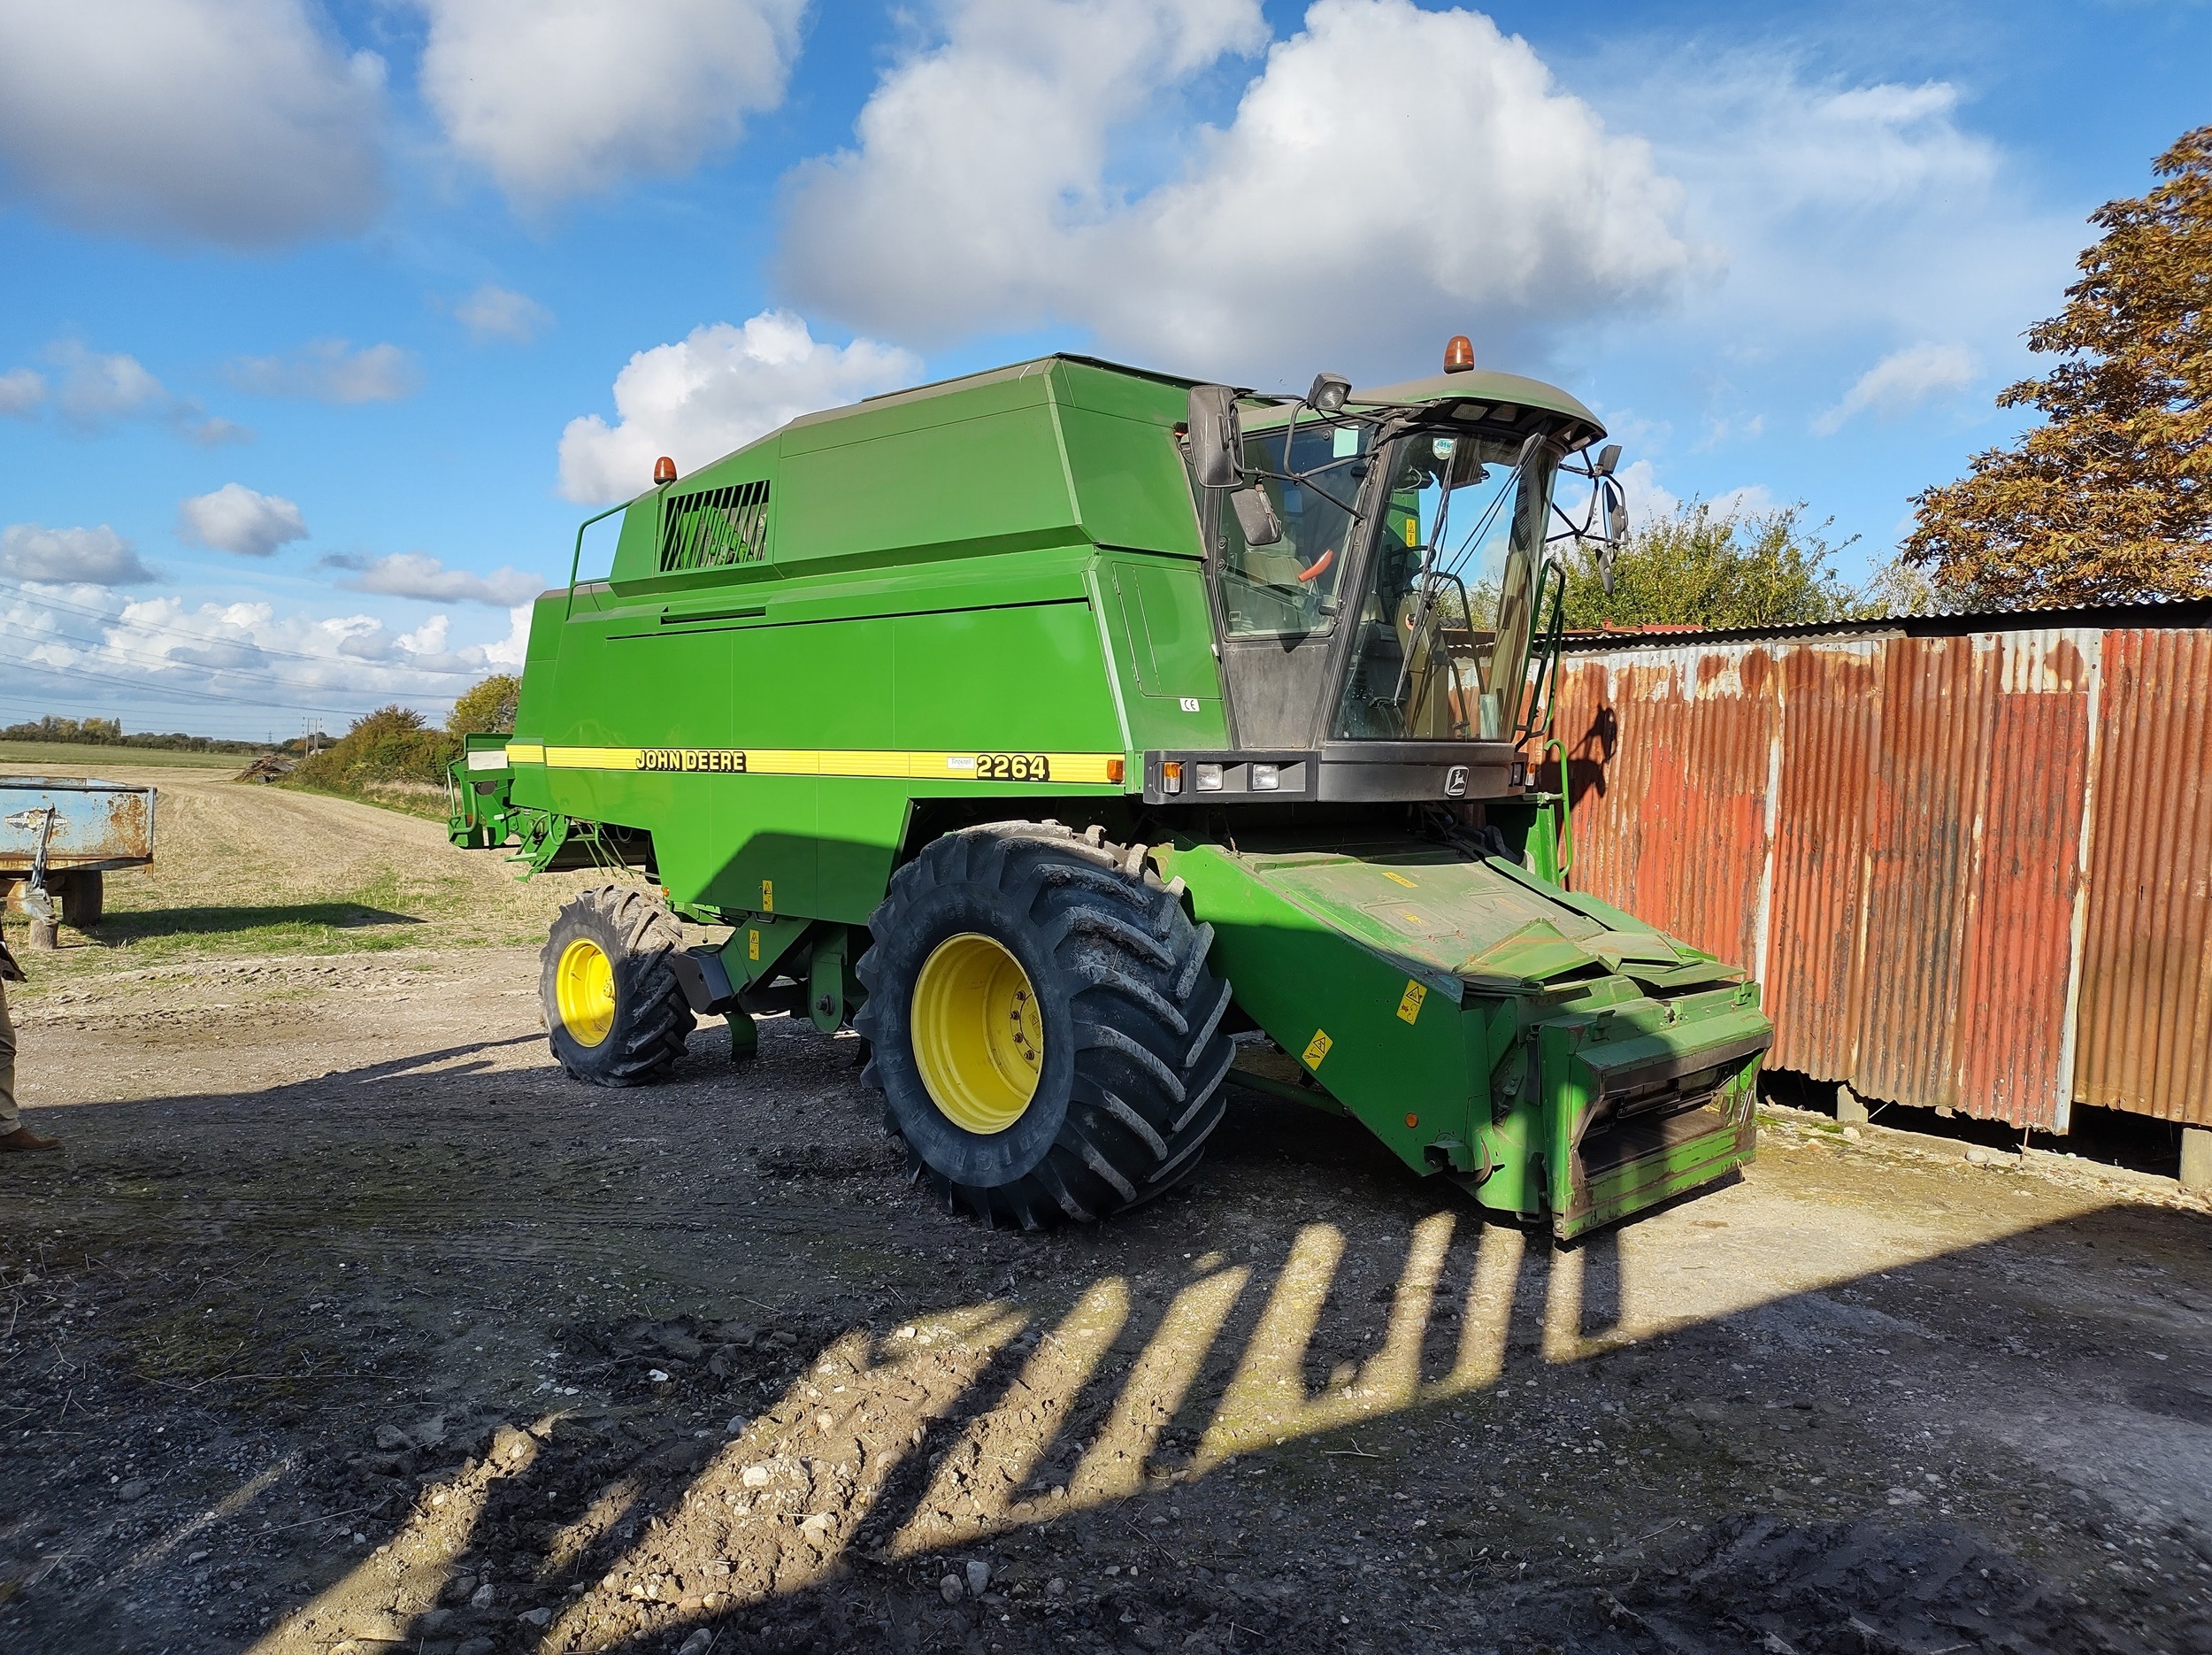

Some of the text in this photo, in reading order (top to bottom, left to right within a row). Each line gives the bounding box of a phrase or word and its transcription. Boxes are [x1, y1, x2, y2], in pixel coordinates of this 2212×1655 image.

[1184, 699, 1196, 711] CE
[636, 750, 747, 773] JOHN DEERE
[976, 754, 1050, 781] 2264
